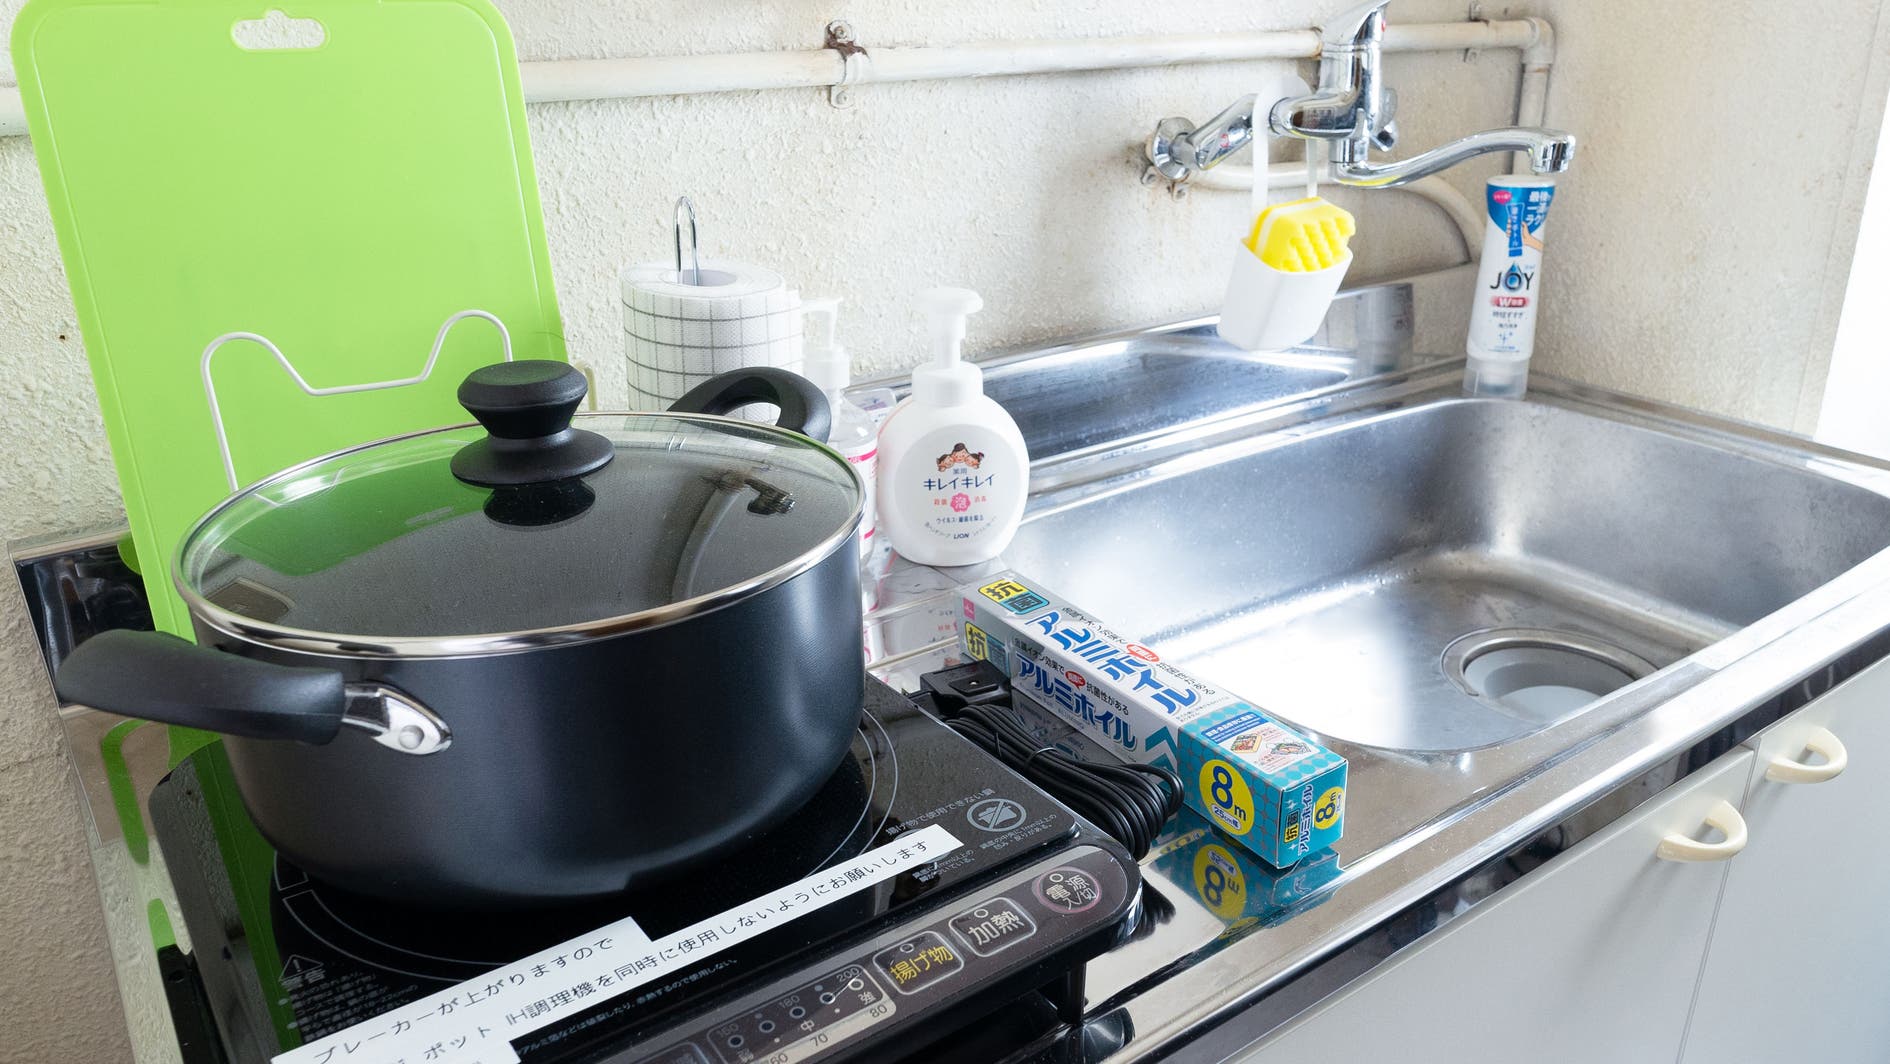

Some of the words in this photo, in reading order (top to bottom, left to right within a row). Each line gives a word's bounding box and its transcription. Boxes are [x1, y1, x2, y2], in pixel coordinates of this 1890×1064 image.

[1490, 271, 1535, 291] JOY
[923, 474, 996, 491] キレイキレイ
[985, 581, 1044, 612] 抗菌
[1024, 611, 1197, 714] アルミホイル
[1016, 652, 1136, 750] アルミホイル
[1086, 682, 1129, 716] 抗菌性がある
[1299, 785, 1313, 855] アルミホイル
[1046, 874, 1090, 900] 電源
[504, 839, 928, 1026] IH調理機を同時に使用しないようにお願いします
[968, 910, 1026, 946] 加熱
[836, 966, 860, 982] 200
[889, 944, 954, 985] 揚げ物
[314, 937, 613, 1064] ブレーカーが上がりますので
[857, 991, 877, 1006] 強
[868, 1004, 888, 1018] 80
[800, 1019, 815, 1032] 中
[809, 1033, 829, 1047] 70
